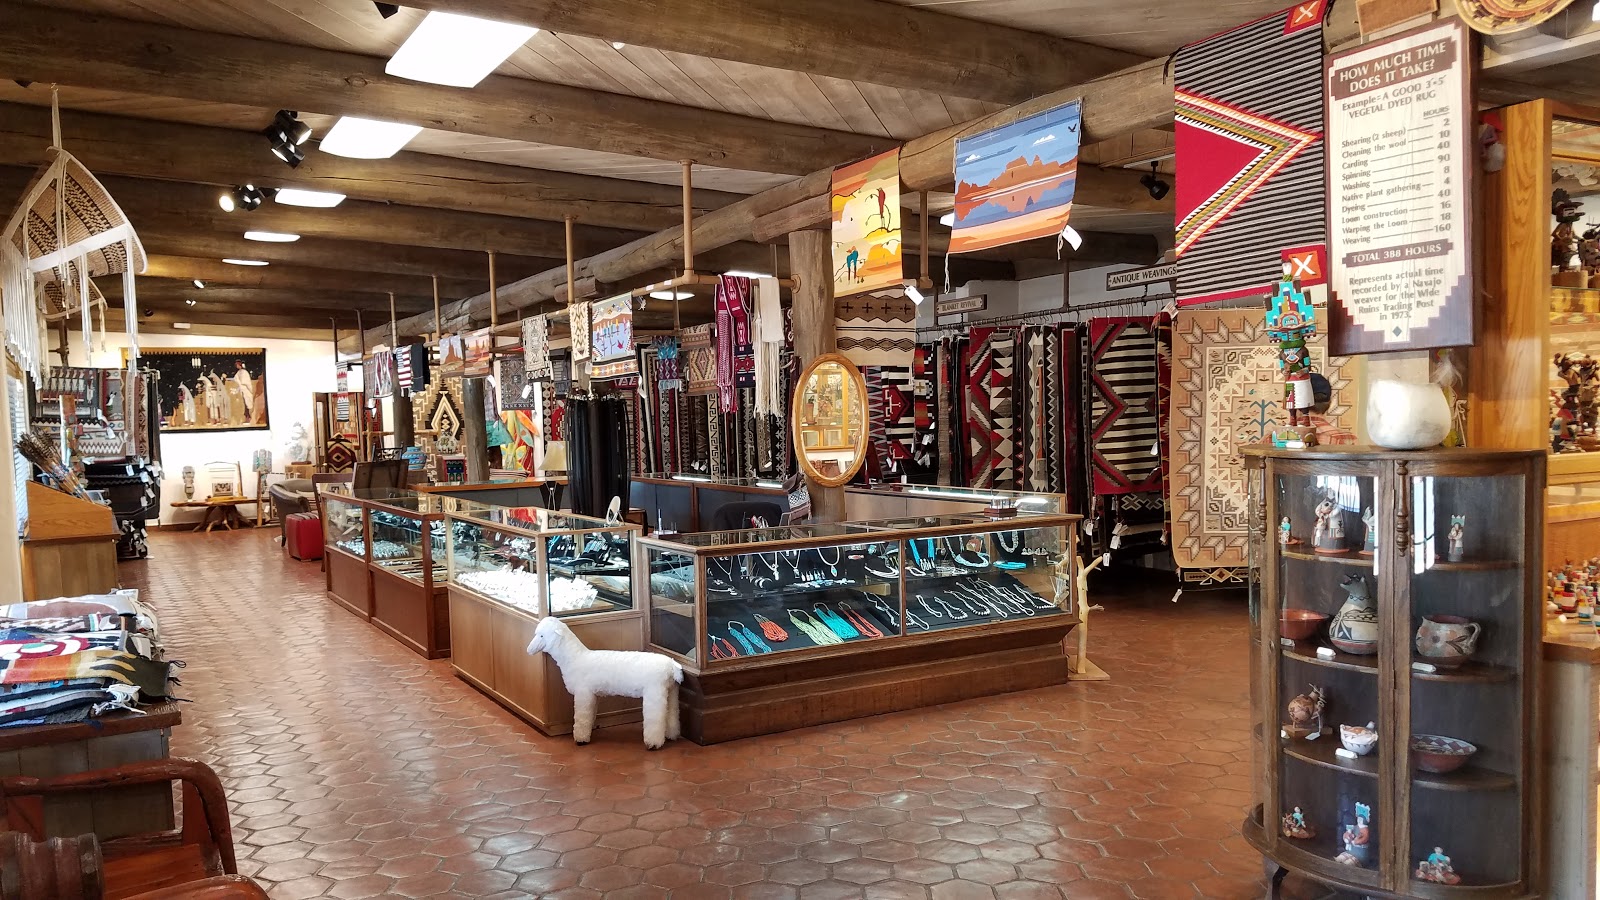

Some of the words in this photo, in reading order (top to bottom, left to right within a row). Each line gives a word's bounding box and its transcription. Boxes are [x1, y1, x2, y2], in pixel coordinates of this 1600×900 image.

[1340, 64, 1369, 82] HOW
[1374, 52, 1411, 72] MUCH
[1416, 42, 1446, 59] TIME
[1350, 75, 1380, 92] DOES
[1385, 70, 1396, 82] IT
[1400, 59, 1435, 78] TAKE?
[1392, 83, 1421, 97] GOOD
[1349, 104, 1385, 119] VEGETAL
[1388, 96, 1412, 109] DYED
[1416, 90, 1436, 102] RUG
[1423, 106, 1449, 117] HOURS
[1342, 136, 1371, 148] Shearing
[1372, 133, 1379, 141] (2
[1382, 126, 1406, 139] sheep)
[1443, 118, 1450, 126] 2
[1342, 147, 1371, 159] Cleaning
[1389, 139, 1406, 149] wool
[1439, 130, 1450, 138] 10
[1342, 159, 1368, 169] Carding
[1437, 141, 1450, 149] 40
[1342, 169, 1371, 181] Spinning
[1438, 154, 1450, 162] 90
[1342, 181, 1370, 191] Washing
[1444, 165, 1450, 173] 8
[1342, 193, 1363, 202] Native
[1366, 189, 1383, 199] plant
[1386, 183, 1421, 196] gathering
[1342, 204, 1366, 214] Dyeing
[1438, 189, 1450, 197] 40
[1342, 216, 1360, 224] Loom
[1364, 207, 1408, 220] construction
[1440, 200, 1451, 209] 16
[1342, 225, 1370, 234] Warping
[1374, 221, 1384, 229] the
[1342, 236, 1371, 245] Weaving
[1434, 223, 1451, 232] 160
[1352, 252, 1380, 263] TOTAL
[1405, 244, 1441, 256] HOURS
[1112, 272, 1140, 284] ANTIQUE
[1142, 266, 1177, 280] WEAVINGS
[1349, 273, 1392, 286] Represents
[1396, 269, 1422, 279] actual
[1425, 267, 1444, 277] time
[1352, 284, 1387, 295] recorded
[1391, 282, 1401, 292] by
[1413, 277, 1442, 288] Navajo
[1354, 295, 1381, 304] weaver
[1401, 291, 1415, 299] the
[1417, 288, 1440, 297] Wide
[1359, 305, 1379, 314] Ruins
[1383, 302, 1412, 312] Trading
[1416, 299, 1434, 308] Post
[1391, 311, 1411, 319] 1973.
